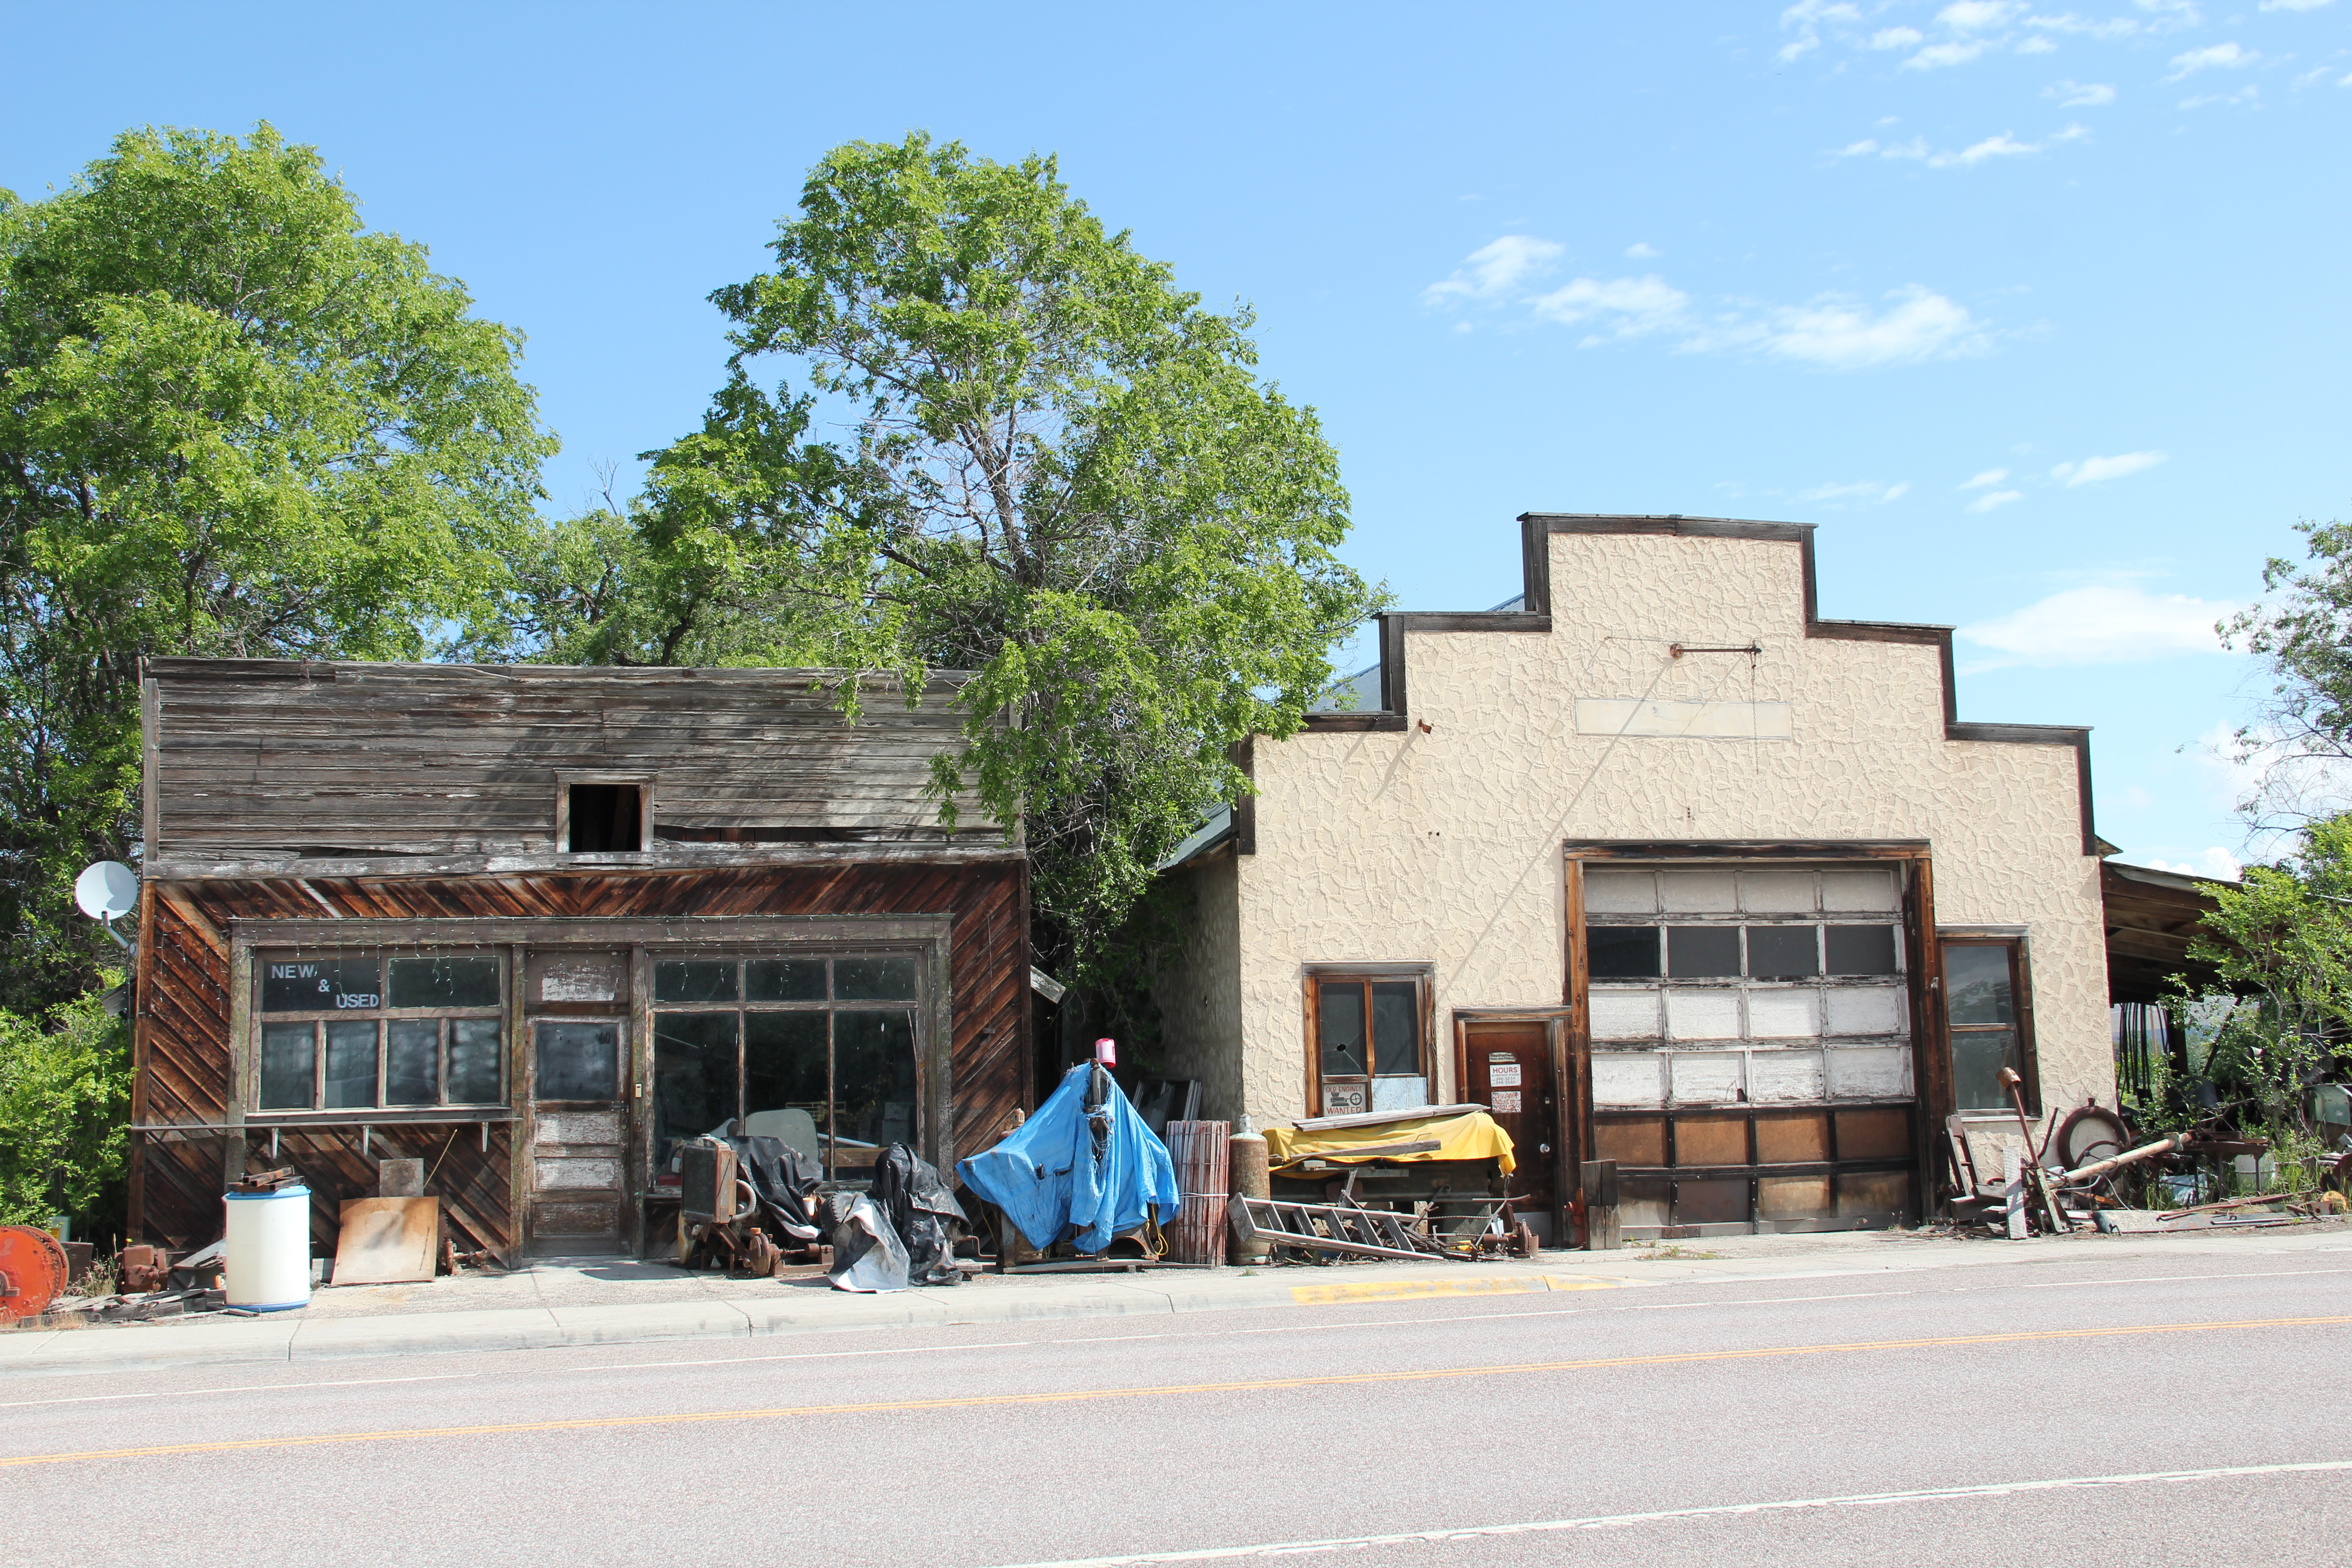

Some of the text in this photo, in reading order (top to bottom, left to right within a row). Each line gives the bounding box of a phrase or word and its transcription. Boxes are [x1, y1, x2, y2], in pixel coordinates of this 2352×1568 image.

[272, 964, 315, 979] NEW
[318, 979, 330, 992] &
[336, 994, 379, 1009] USED
[1326, 1106, 1362, 1115] WANTED
